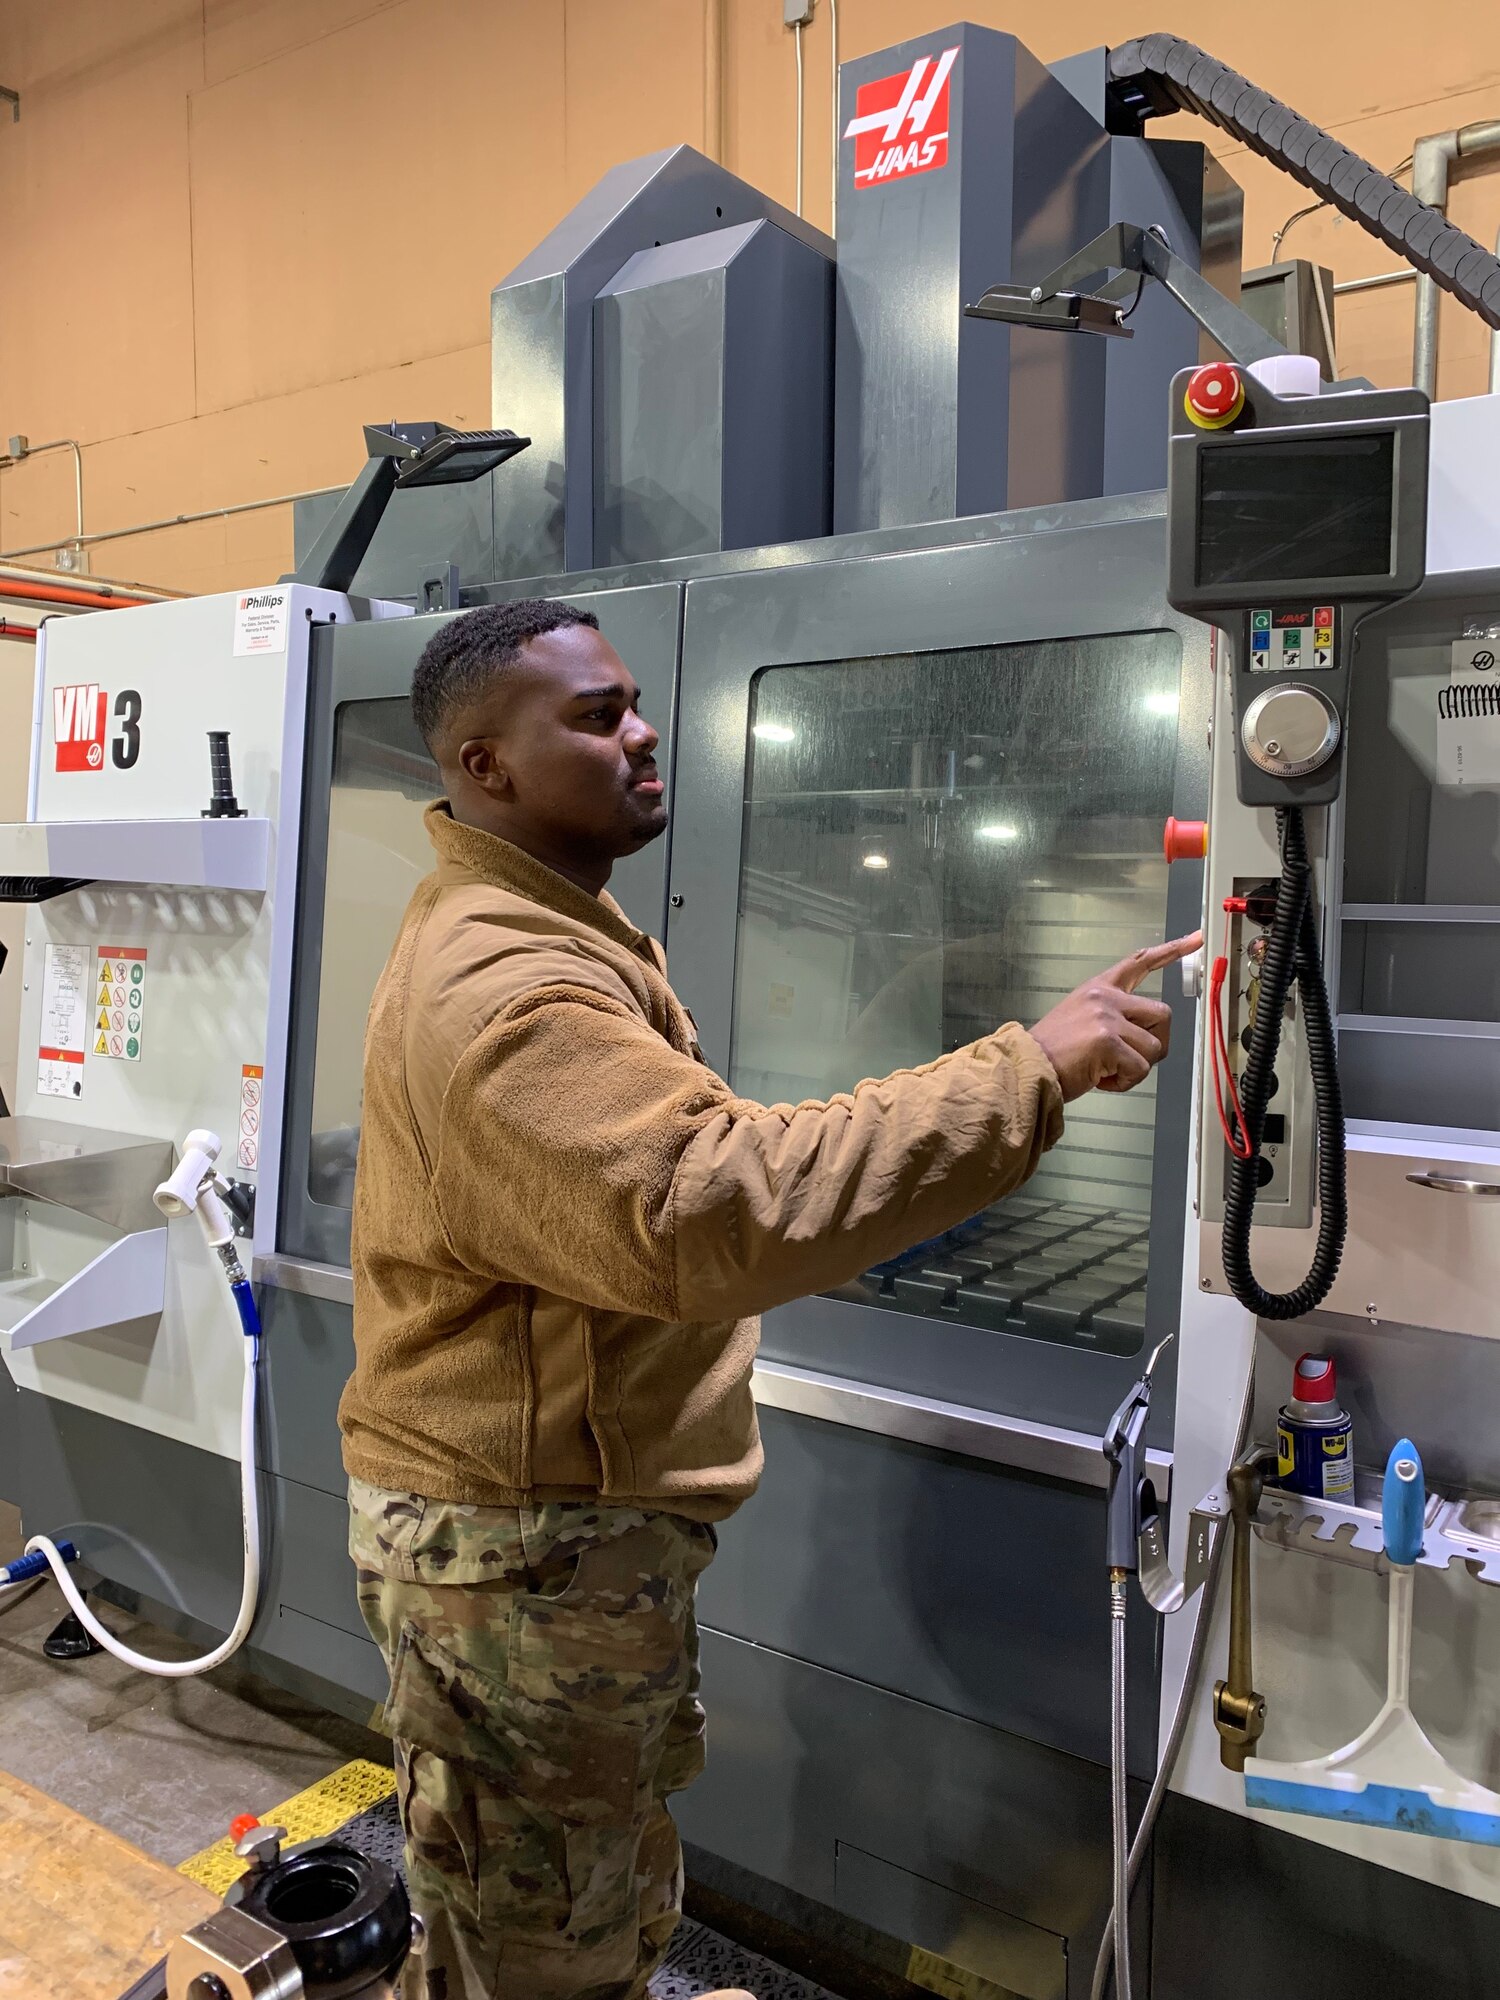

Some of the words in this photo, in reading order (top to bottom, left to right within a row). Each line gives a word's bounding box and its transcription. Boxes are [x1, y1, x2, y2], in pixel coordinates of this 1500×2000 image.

[855, 131, 949, 181] HAAS
[246, 595, 284, 609] Phillips
[1275, 613, 1310, 623] HAAS
[1255, 635, 1268, 646] F1
[1285, 634, 1299, 645] F2
[1316, 632, 1330, 643] F3
[52, 683, 100, 744] VM
[111, 688, 143, 770] 3
[1324, 1436, 1345, 1447] WD-40
